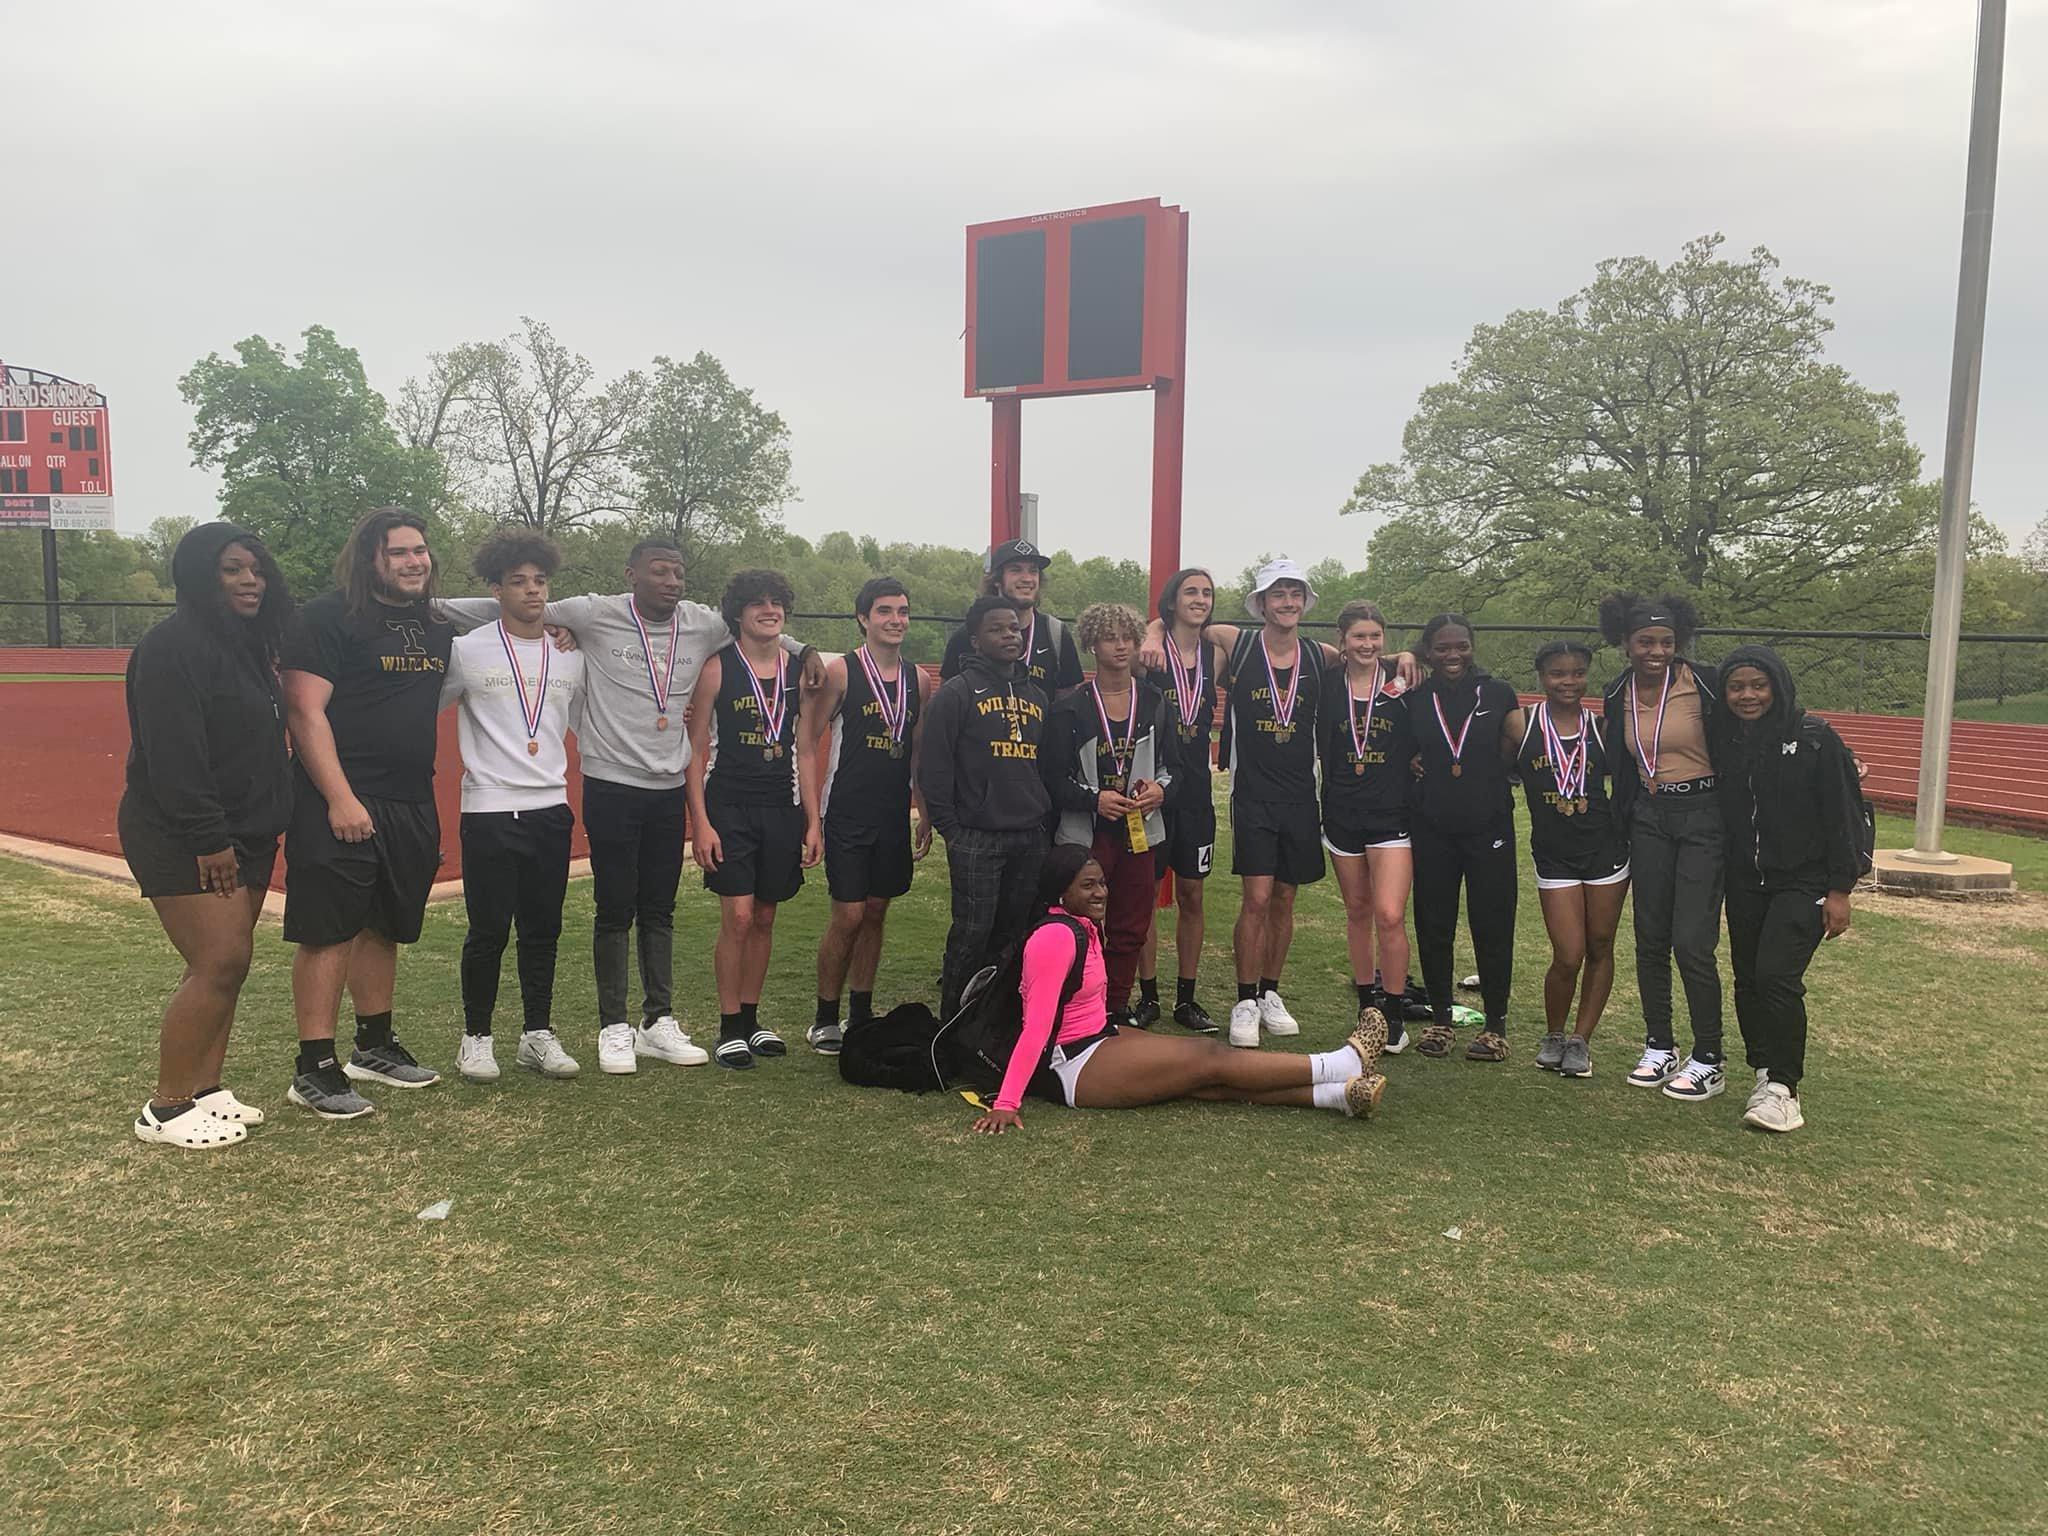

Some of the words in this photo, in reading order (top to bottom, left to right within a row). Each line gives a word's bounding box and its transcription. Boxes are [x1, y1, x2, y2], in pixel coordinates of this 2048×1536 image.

[1032, 209, 1087, 223] DAKTRONICS
[3, 384, 97, 408] REDSKINS
[53, 410, 97, 426] GUEST
[19, 454, 32, 468] ON
[46, 455, 66, 468] QTR
[80, 480, 105, 493] T.O.L.
[977, 696, 1043, 722] WILDCAT
[1256, 719, 1297, 733] TRAK
[991, 741, 1037, 760] TRACK
[1201, 847, 1211, 868] 4
